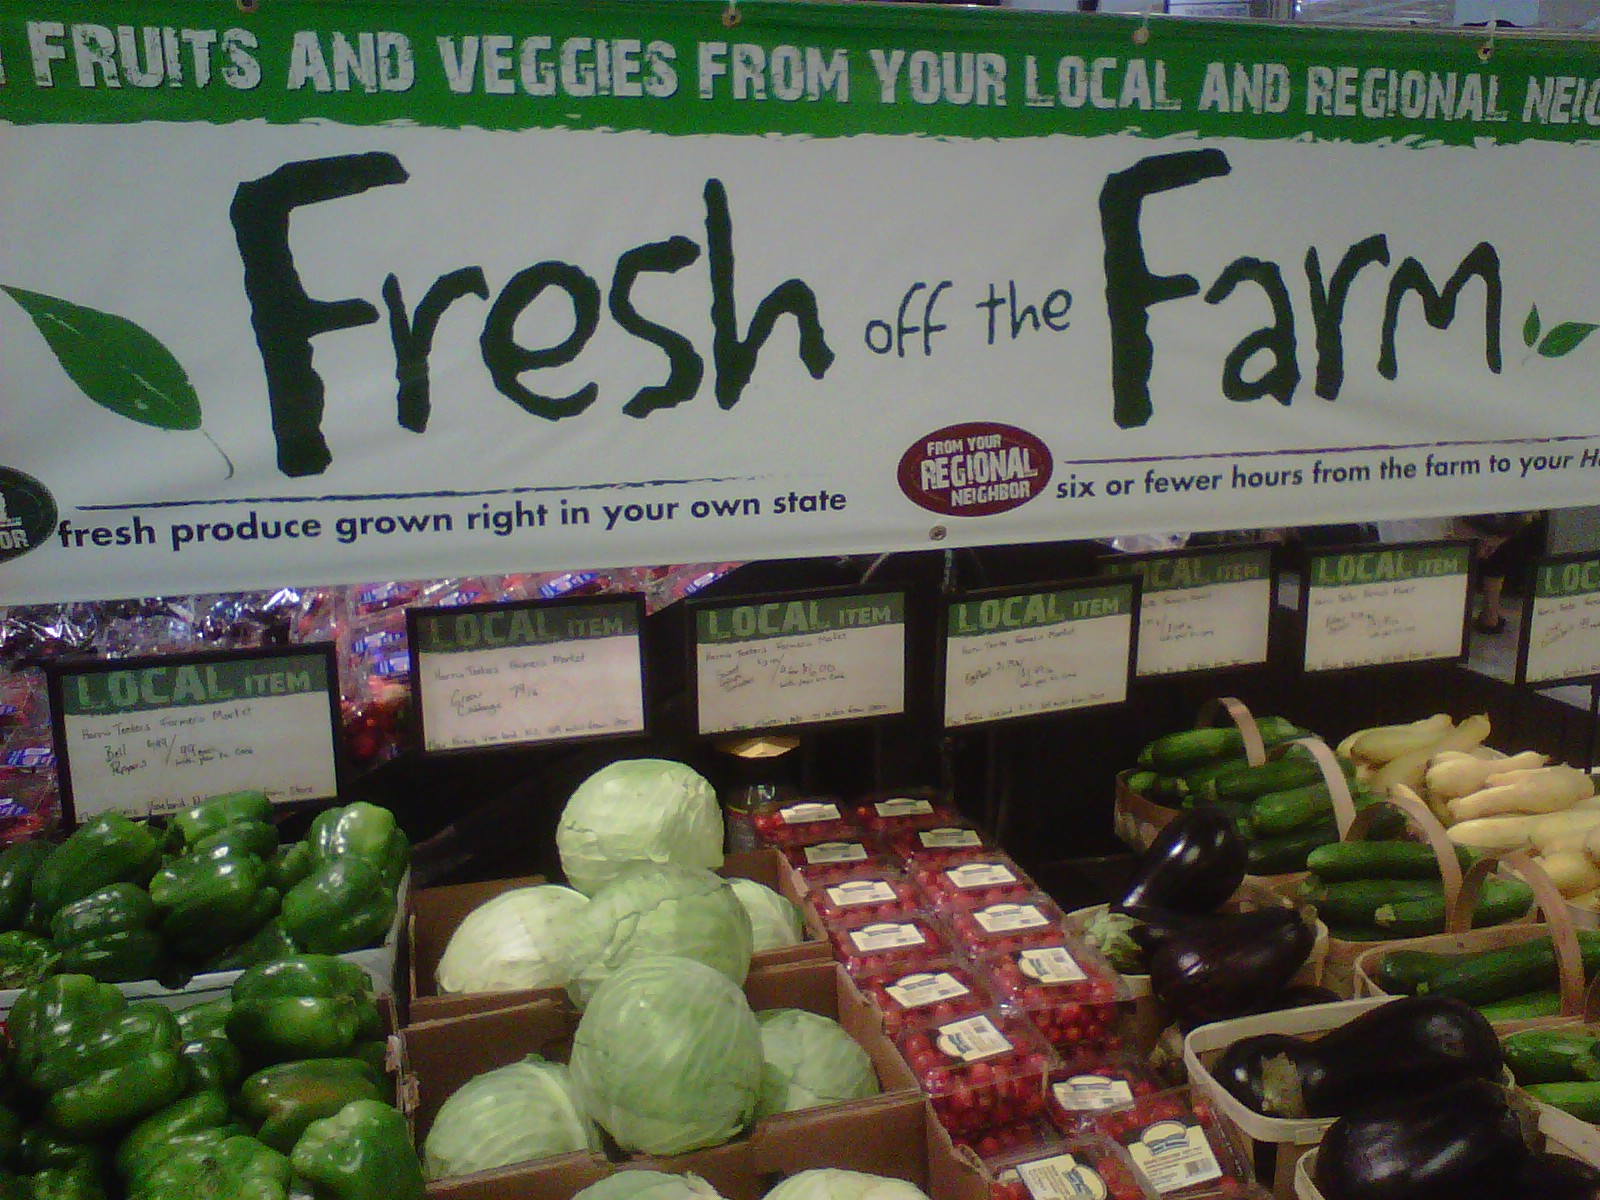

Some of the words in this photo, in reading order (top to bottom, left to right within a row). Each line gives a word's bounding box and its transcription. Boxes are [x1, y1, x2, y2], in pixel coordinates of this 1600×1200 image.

[27, 21, 262, 89] FRUITS
[287, 31, 415, 93] AND
[437, 35, 679, 98] VEGGIES
[698, 41, 851, 102] FROM
[869, 50, 1007, 107] YOUR
[1025, 55, 1182, 111] LOCAL
[1198, 62, 1291, 114] AND
[1306, 66, 1509, 122] REGIONAL
[230, 151, 834, 477] Fresh
[865, 280, 953, 358] off
[975, 279, 1073, 345] the
[1099, 148, 1502, 429] Farm
[927, 439, 963, 456] FROM
[967, 434, 1001, 452] YOUR
[921, 447, 1038, 491] REGIONAL
[1056, 473, 1096, 499] six
[1106, 480, 1134, 496] or
[1144, 469, 1222, 494] fewer
[1232, 464, 1303, 489] hours
[1313, 460, 1370, 484] from
[1380, 456, 1416, 479] the
[1426, 453, 1480, 477] farm
[1490, 454, 1511, 473] to
[1520, 454, 1574, 478] your
[952, 480, 1030, 507] NEIGHBOR
[58, 515, 156, 548] fresh
[171, 511, 321, 551] produce
[335, 512, 453, 544] grown
[467, 501, 548, 537] right
[561, 499, 590, 525] in
[603, 501, 679, 531] your
[691, 498, 760, 519] own
[773, 490, 847, 514] state
[1320, 551, 1411, 583] LOCAL
[430, 608, 552, 647] LOCAL
[567, 616, 623, 637] ITEM
[708, 600, 830, 638] LOCAL
[838, 605, 891, 625] ITEM
[958, 593, 1065, 632] LOCAL
[1073, 598, 1119, 617] ITEM
[76, 664, 234, 709] LOCAL
[245, 671, 312, 695] ITEM
